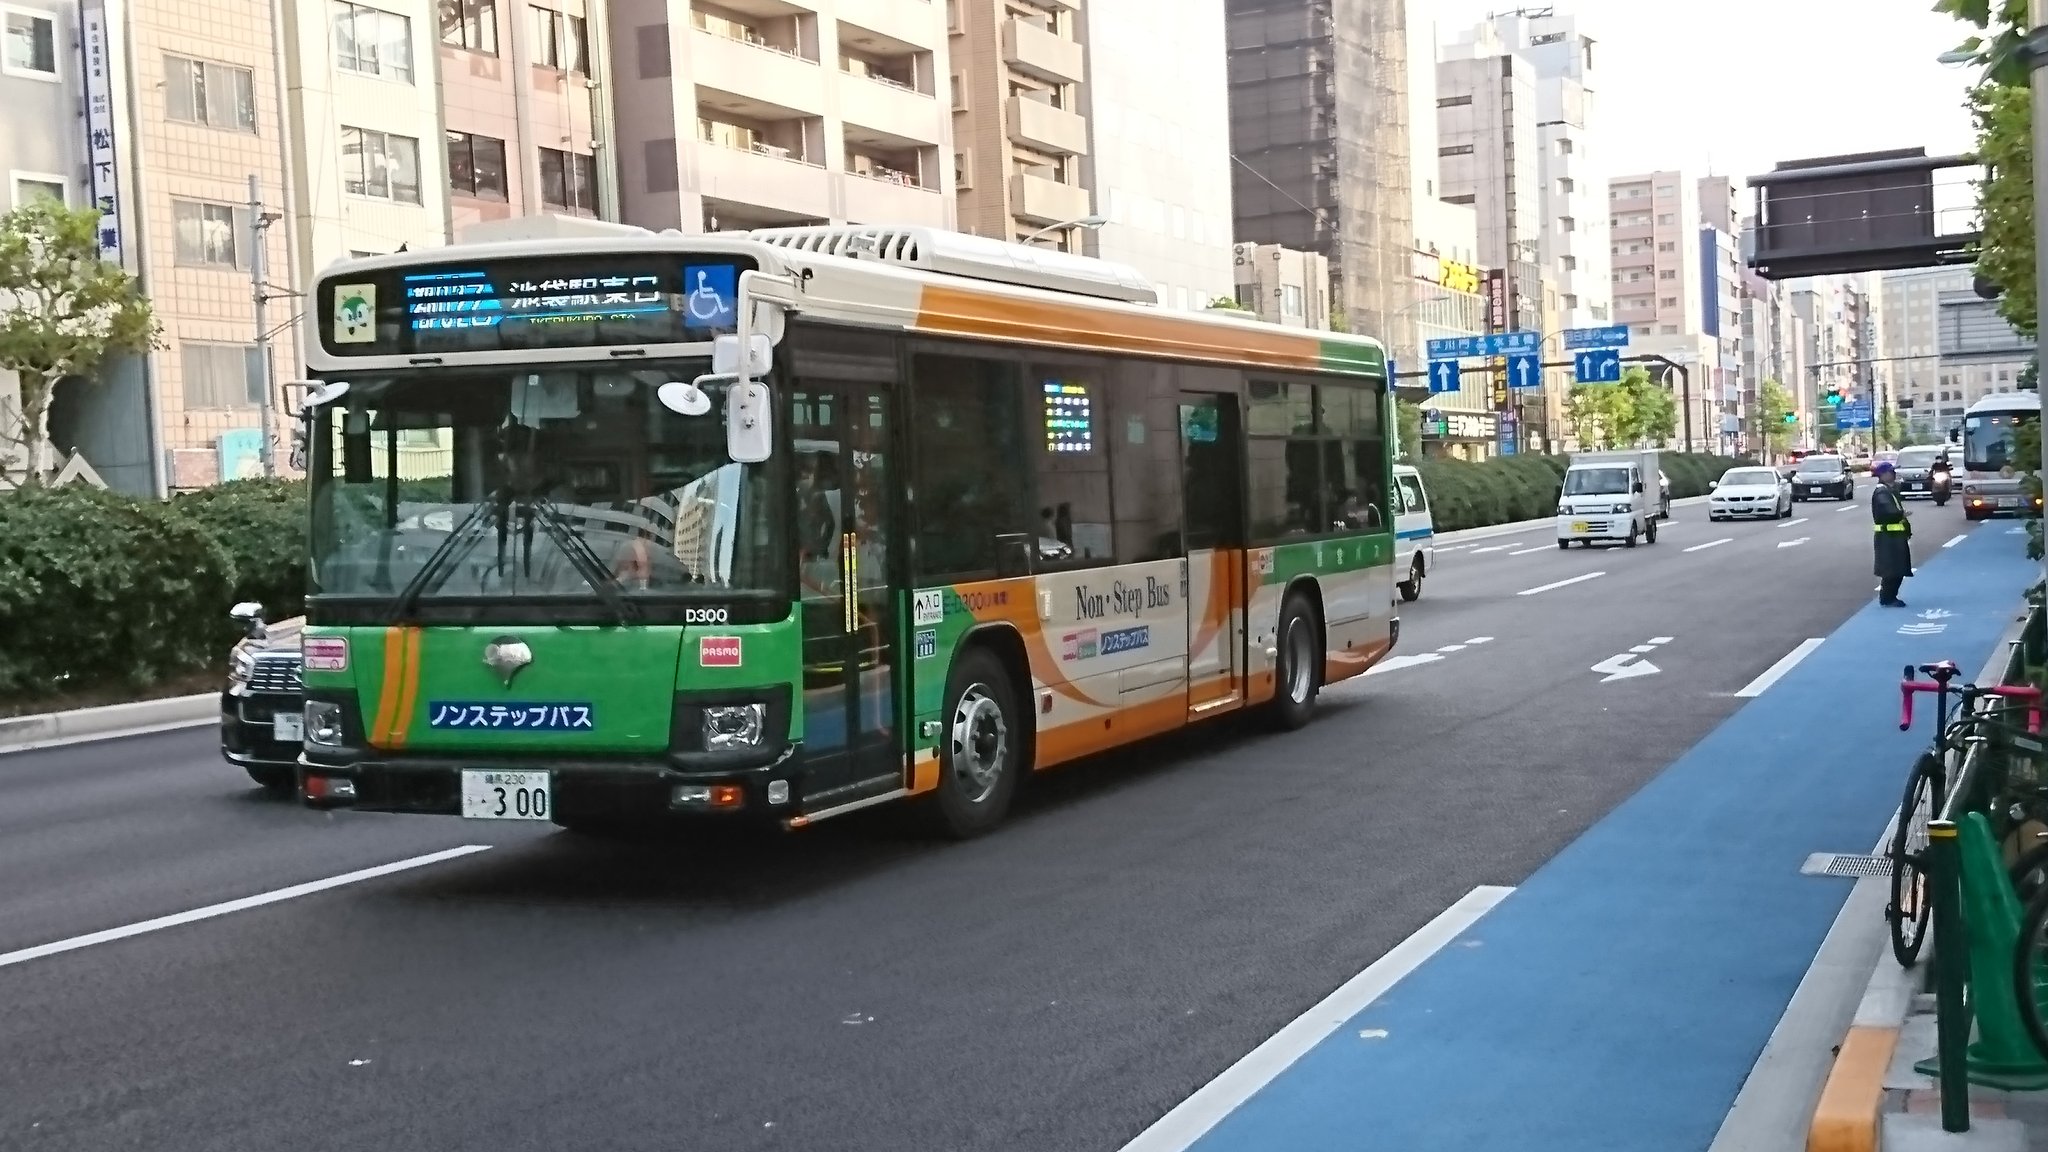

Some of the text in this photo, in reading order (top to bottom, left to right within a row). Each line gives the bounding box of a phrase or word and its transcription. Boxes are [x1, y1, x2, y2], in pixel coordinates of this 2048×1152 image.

[1147, 576, 1169, 609] Bus
[925, 594, 940, 610] 入口
[685, 608, 728, 623] D300
[702, 647, 739, 657] PASMO
[430, 704, 593, 728] ノンステップバス
